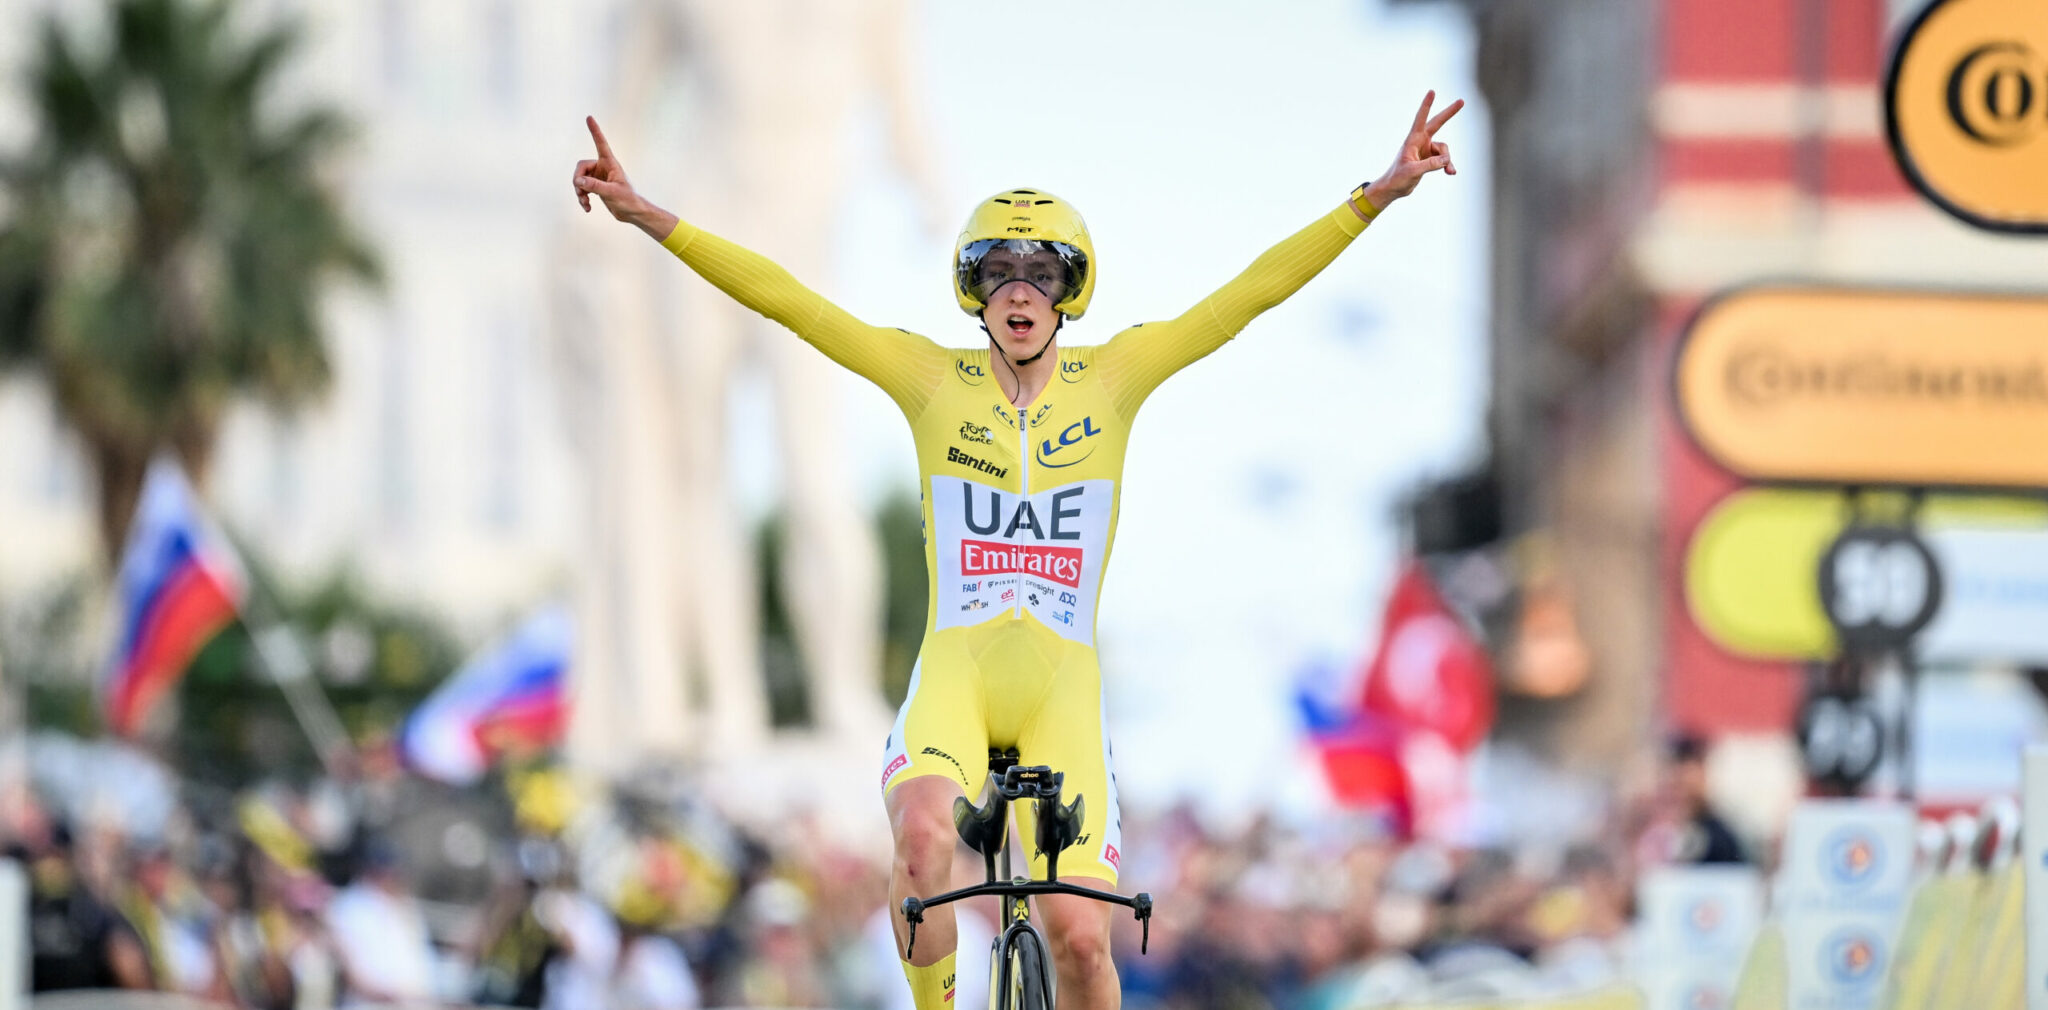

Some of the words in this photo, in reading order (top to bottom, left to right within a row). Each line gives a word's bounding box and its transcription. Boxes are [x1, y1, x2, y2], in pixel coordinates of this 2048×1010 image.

[958, 359, 985, 377] LCL
[1062, 360, 1088, 374] LCL
[995, 404, 1015, 427] LCL
[1031, 403, 1053, 426] LCL
[1042, 416, 1101, 457] LCL
[947, 446, 1008, 479] Santini
[963, 481, 1085, 541] UAE
[963, 544, 1080, 583] Emirates
[943, 973, 956, 989] UA
